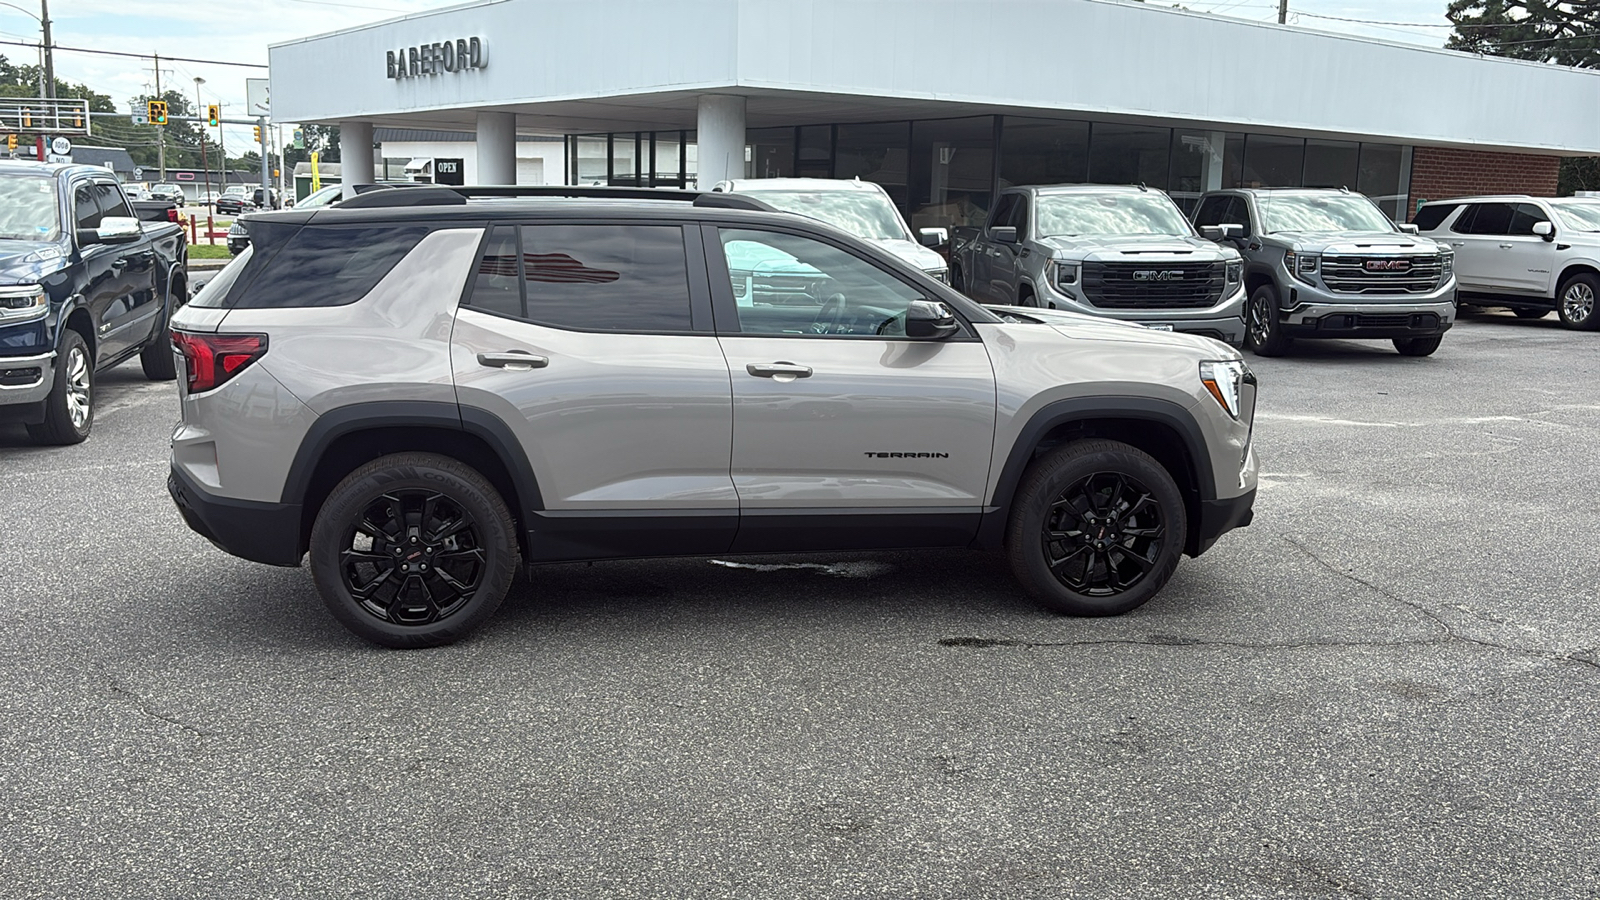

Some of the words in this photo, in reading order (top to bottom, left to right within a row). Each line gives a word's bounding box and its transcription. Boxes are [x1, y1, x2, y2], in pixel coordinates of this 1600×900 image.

[386, 36, 487, 80] BAREFORD
[54, 141, 69, 150] 1008
[438, 162, 457, 173] OPEN
[1366, 260, 1410, 270] GMC
[1133, 271, 1185, 281] GMC
[864, 451, 949, 459] TERRAIN
